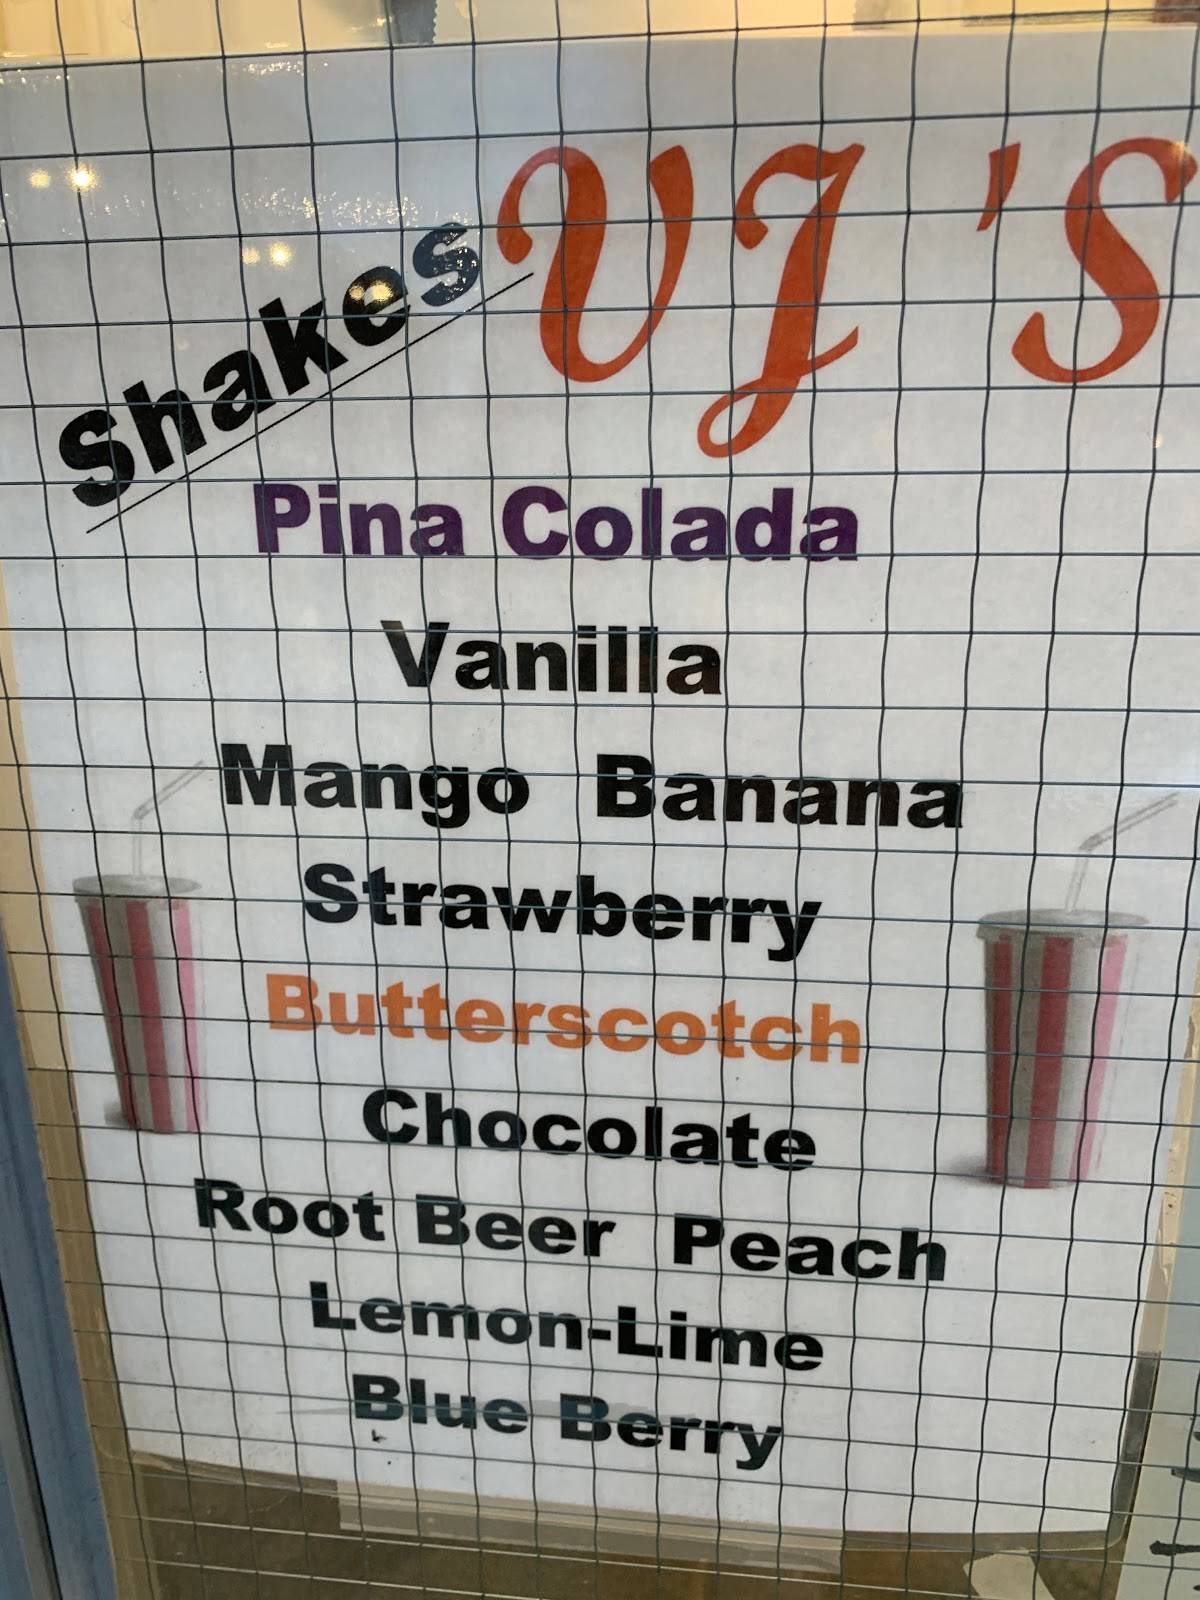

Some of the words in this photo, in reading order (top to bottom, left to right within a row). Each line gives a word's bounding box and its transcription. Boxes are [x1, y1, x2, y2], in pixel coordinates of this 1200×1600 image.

[58, 222, 481, 507] Shakes
[253, 482, 465, 557] Pina
[501, 485, 858, 561] Colada
[380, 620, 722, 695] Vanilla
[220, 743, 530, 828] Mango
[596, 754, 964, 828] Banana
[302, 863, 823, 962] Strawberry
[265, 973, 861, 1064] Butterscotch
[362, 1089, 817, 1171] Chocolate
[193, 1177, 386, 1242] Root
[416, 1193, 616, 1257] Beer
[673, 1213, 947, 1281] Peach
[309, 1281, 824, 1371] Lemon-Lime
[352, 1374, 530, 1434] Blue
[560, 1393, 783, 1470] Berry
